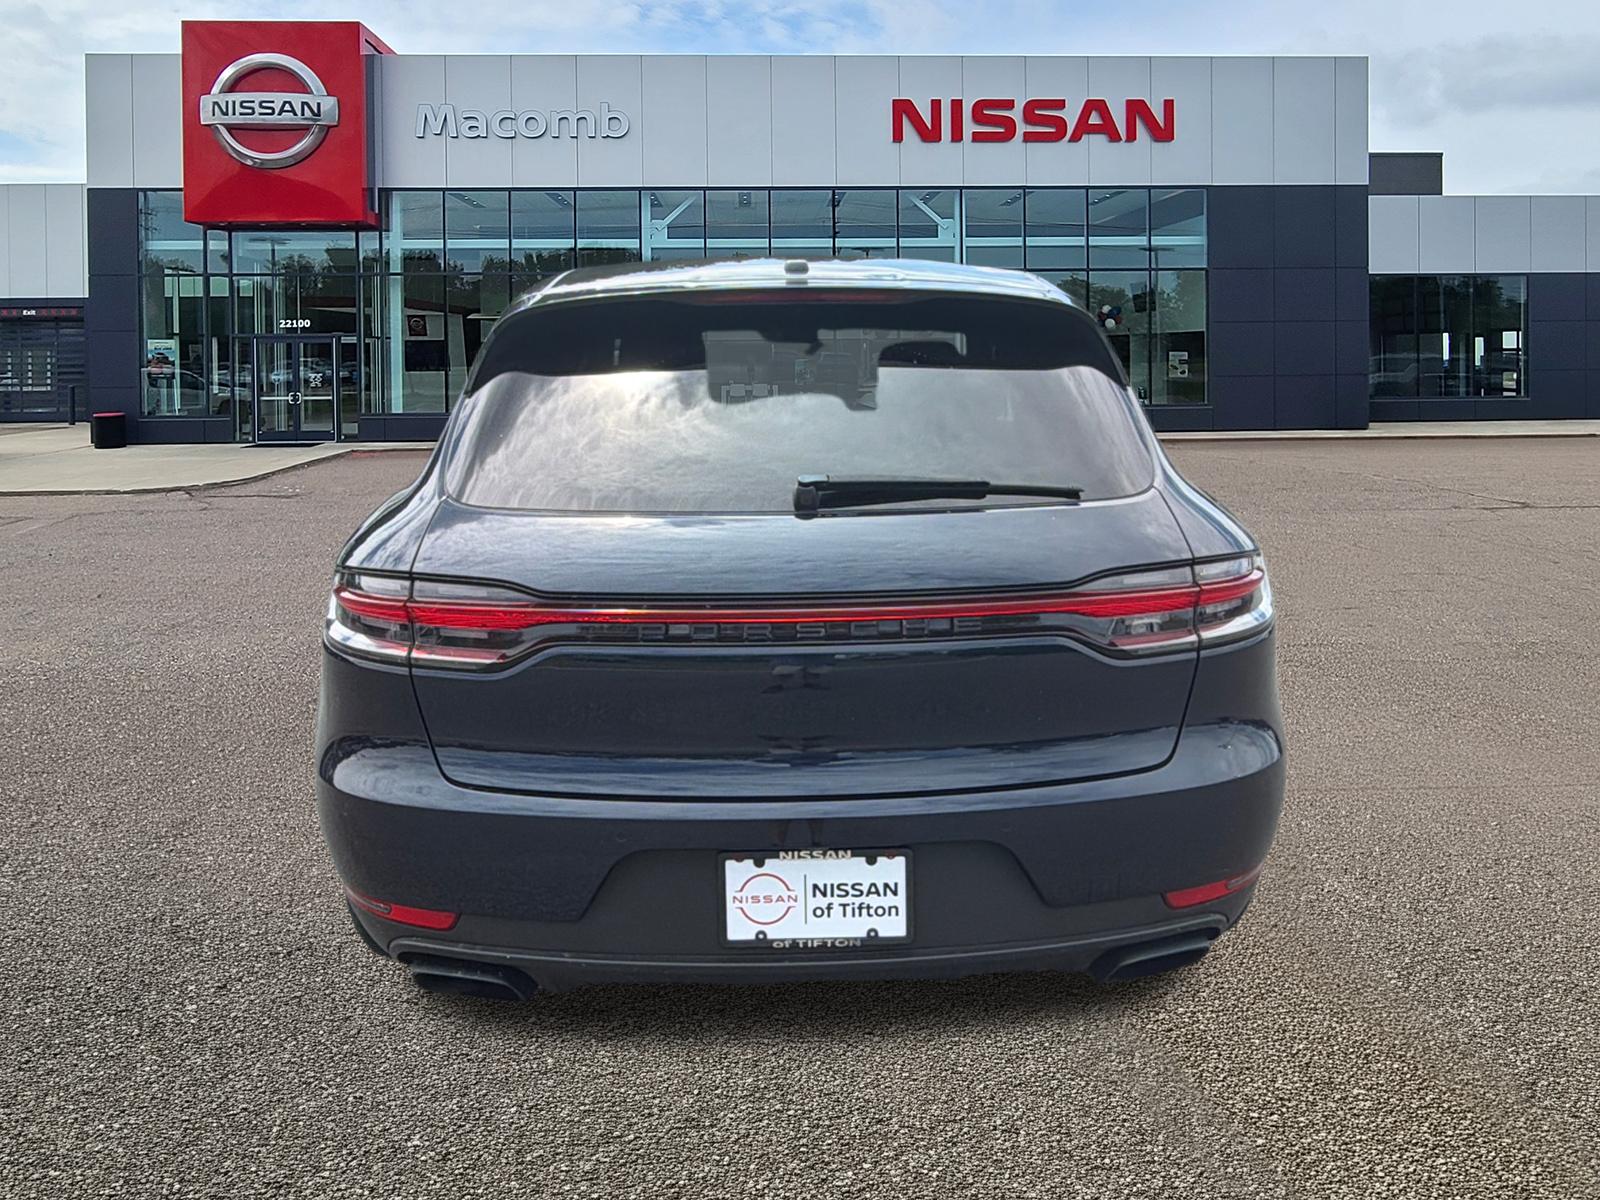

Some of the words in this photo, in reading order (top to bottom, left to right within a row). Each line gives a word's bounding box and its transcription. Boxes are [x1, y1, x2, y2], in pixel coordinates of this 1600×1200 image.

[211, 99, 322, 118] NISSAN
[415, 102, 630, 138] Macomb
[892, 98, 1175, 142] NISSAN
[279, 319, 311, 328] 22100
[638, 618, 982, 642] PORSCHE
[778, 850, 852, 860] NISSAN
[812, 882, 899, 898] NISSAN
[732, 895, 798, 904] NISSAN
[812, 902, 833, 918] of
[838, 903, 899, 918] Tifton
[796, 938, 861, 948] TIFTON
